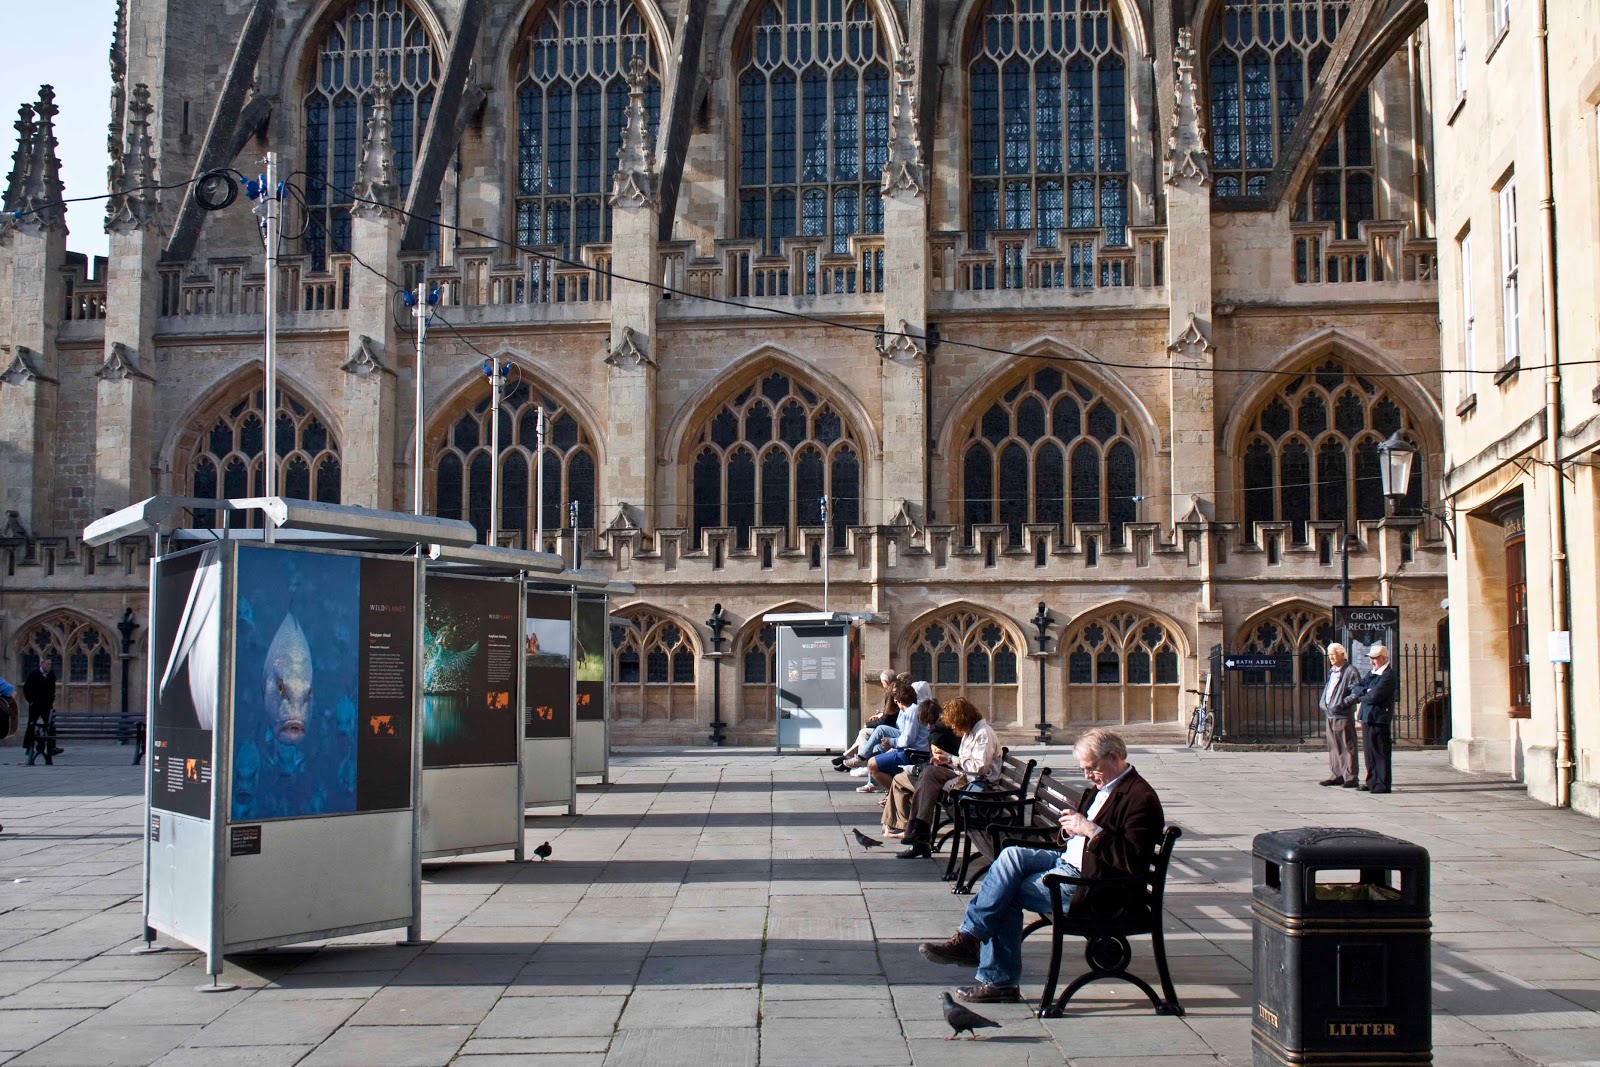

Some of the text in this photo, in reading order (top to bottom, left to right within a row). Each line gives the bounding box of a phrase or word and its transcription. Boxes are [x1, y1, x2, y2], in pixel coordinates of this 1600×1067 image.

[369, 604, 406, 613] WILDPLANET
[1350, 612, 1384, 621] ORGAN
[1348, 622, 1386, 631] RECITALS
[1258, 1004, 1279, 1028] LITTER
[1328, 1023, 1396, 1036] LITTER
